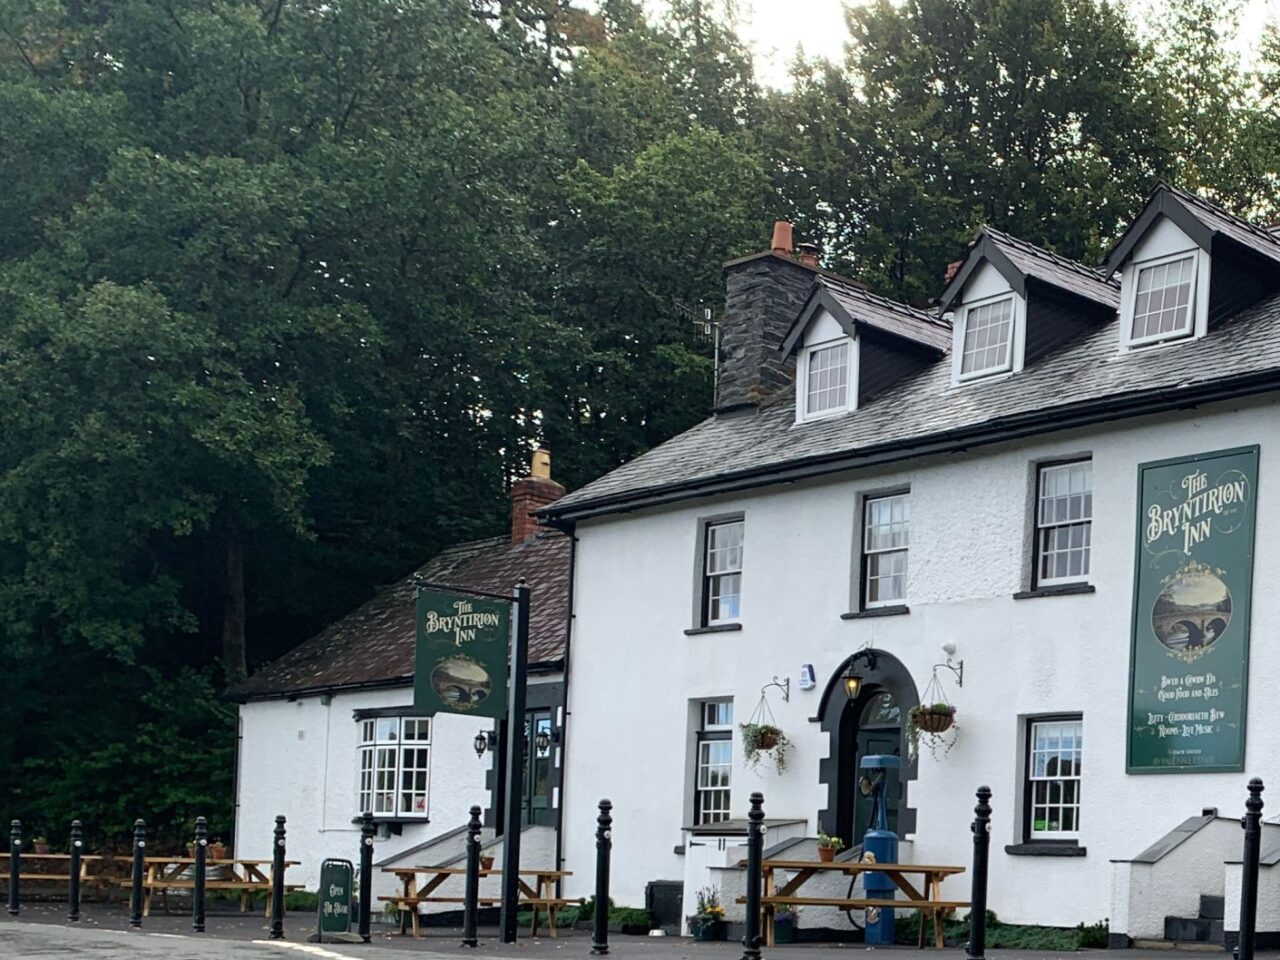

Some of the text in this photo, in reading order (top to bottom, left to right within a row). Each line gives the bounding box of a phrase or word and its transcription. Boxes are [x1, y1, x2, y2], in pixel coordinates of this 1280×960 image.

[1182, 469, 1207, 500] THE
[1147, 481, 1245, 543] BRYNTIRION
[1181, 517, 1212, 556] INN
[453, 600, 473, 616] THE
[426, 611, 500, 633] BRYNTIRION
[453, 627, 476, 647] INN
[1176, 687, 1190, 701] FOOD
[1158, 724, 1179, 739] ROOMS
